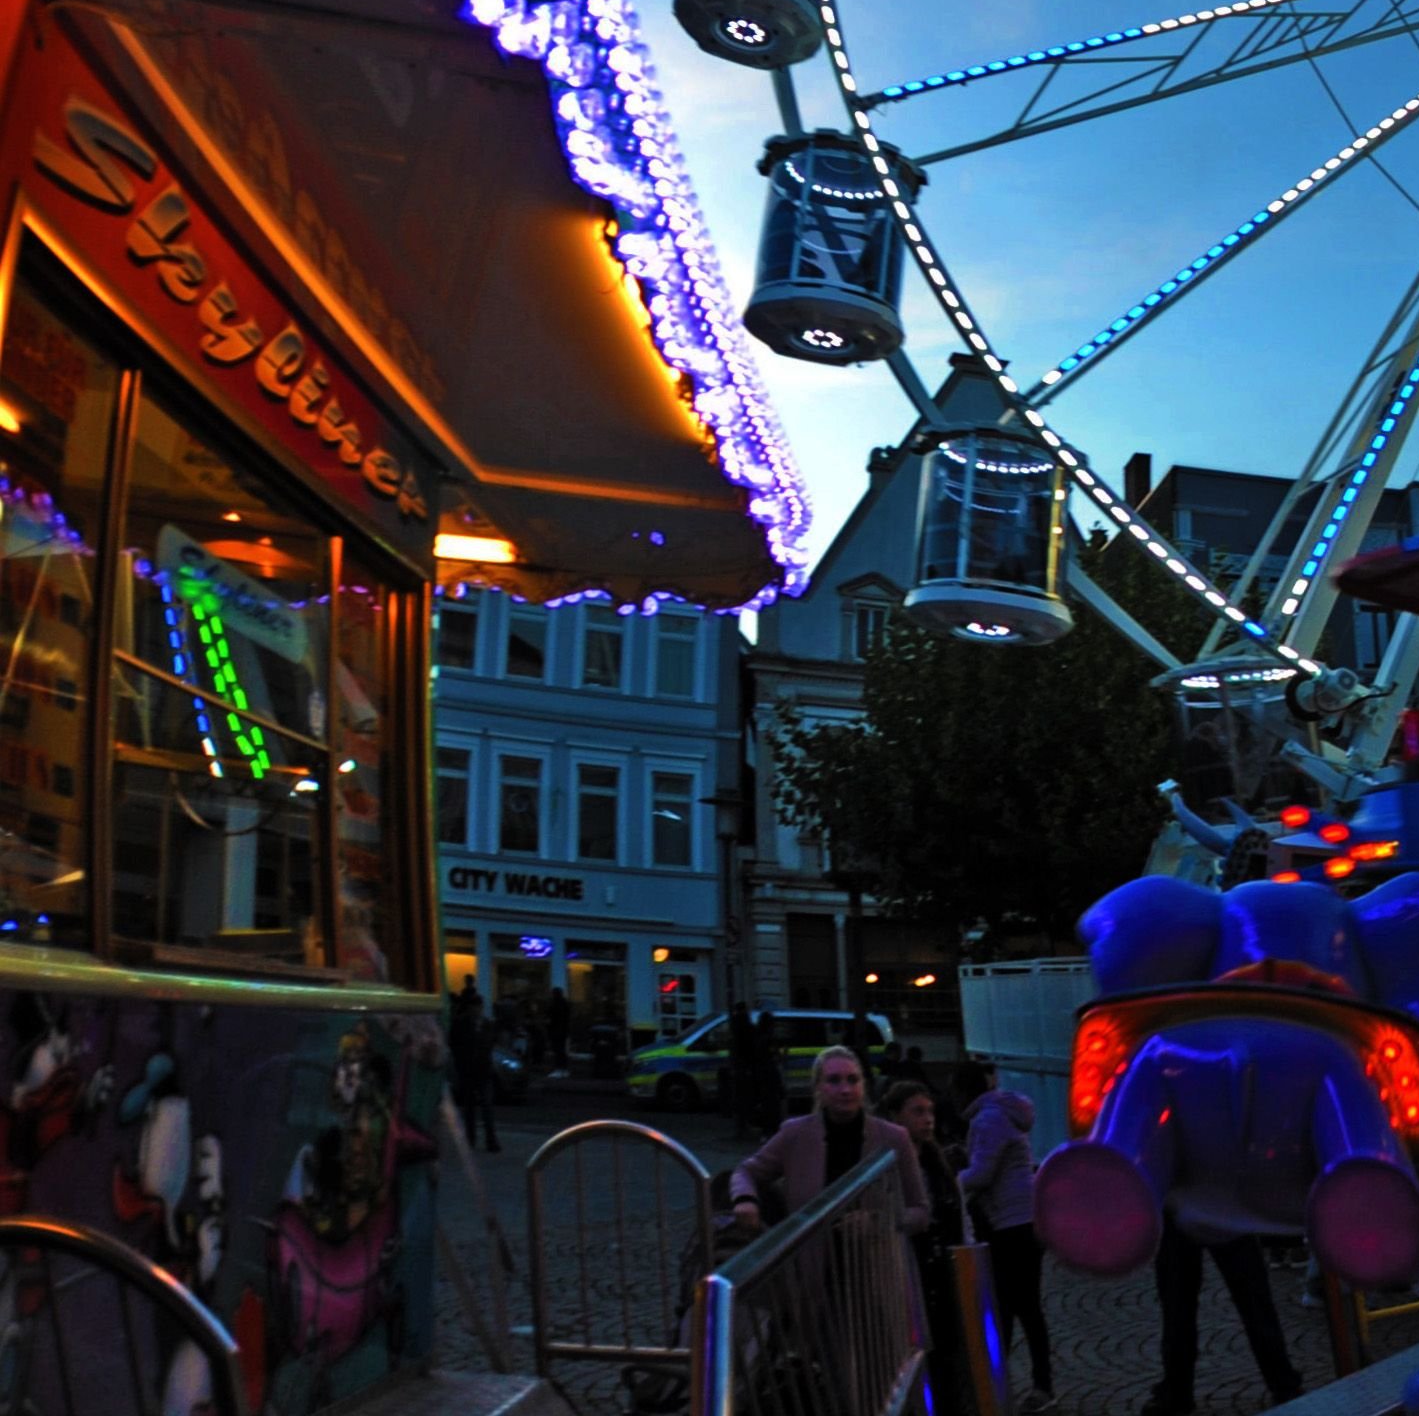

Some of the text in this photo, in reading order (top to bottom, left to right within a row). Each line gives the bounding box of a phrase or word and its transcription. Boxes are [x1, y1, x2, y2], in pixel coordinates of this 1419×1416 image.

[33, 94, 427, 517] Skyliner
[450, 867, 583, 901] CITY WACHE
